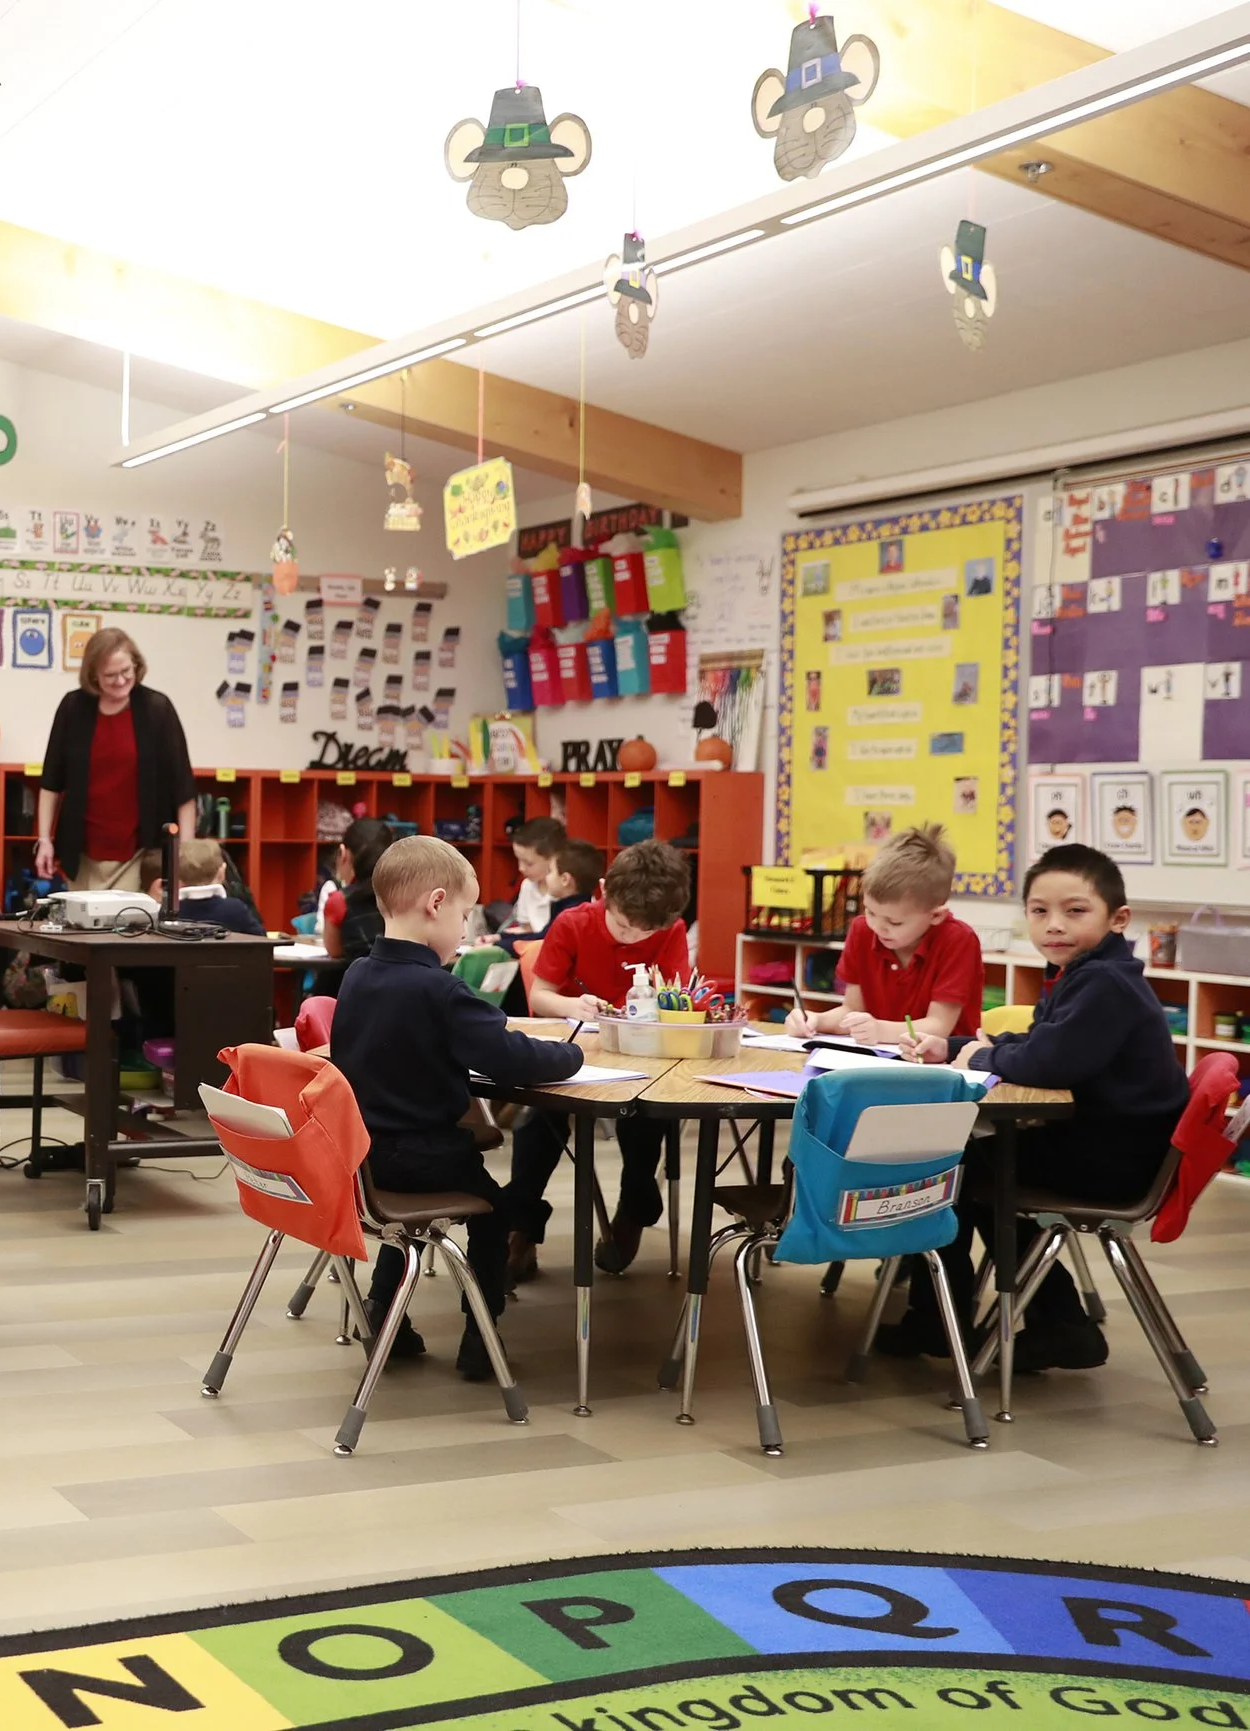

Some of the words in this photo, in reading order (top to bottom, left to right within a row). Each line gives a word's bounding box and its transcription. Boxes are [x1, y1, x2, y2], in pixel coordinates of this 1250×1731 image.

[521, 527, 567, 550] HAPPY
[311, 731, 410, 771] Dream
[561, 739, 625, 772] PRAY
[876, 1195, 931, 1215] Branson
[16, 1653, 206, 1729] N
[278, 1623, 435, 1681] O
[518, 1594, 636, 1650] P
[770, 1578, 959, 1640] Q
[1061, 1596, 1214, 1658] R
[551, 1685, 916, 1731] kingdom
[936, 1679, 1023, 1710] of
[1050, 1686, 1250, 1730] God
